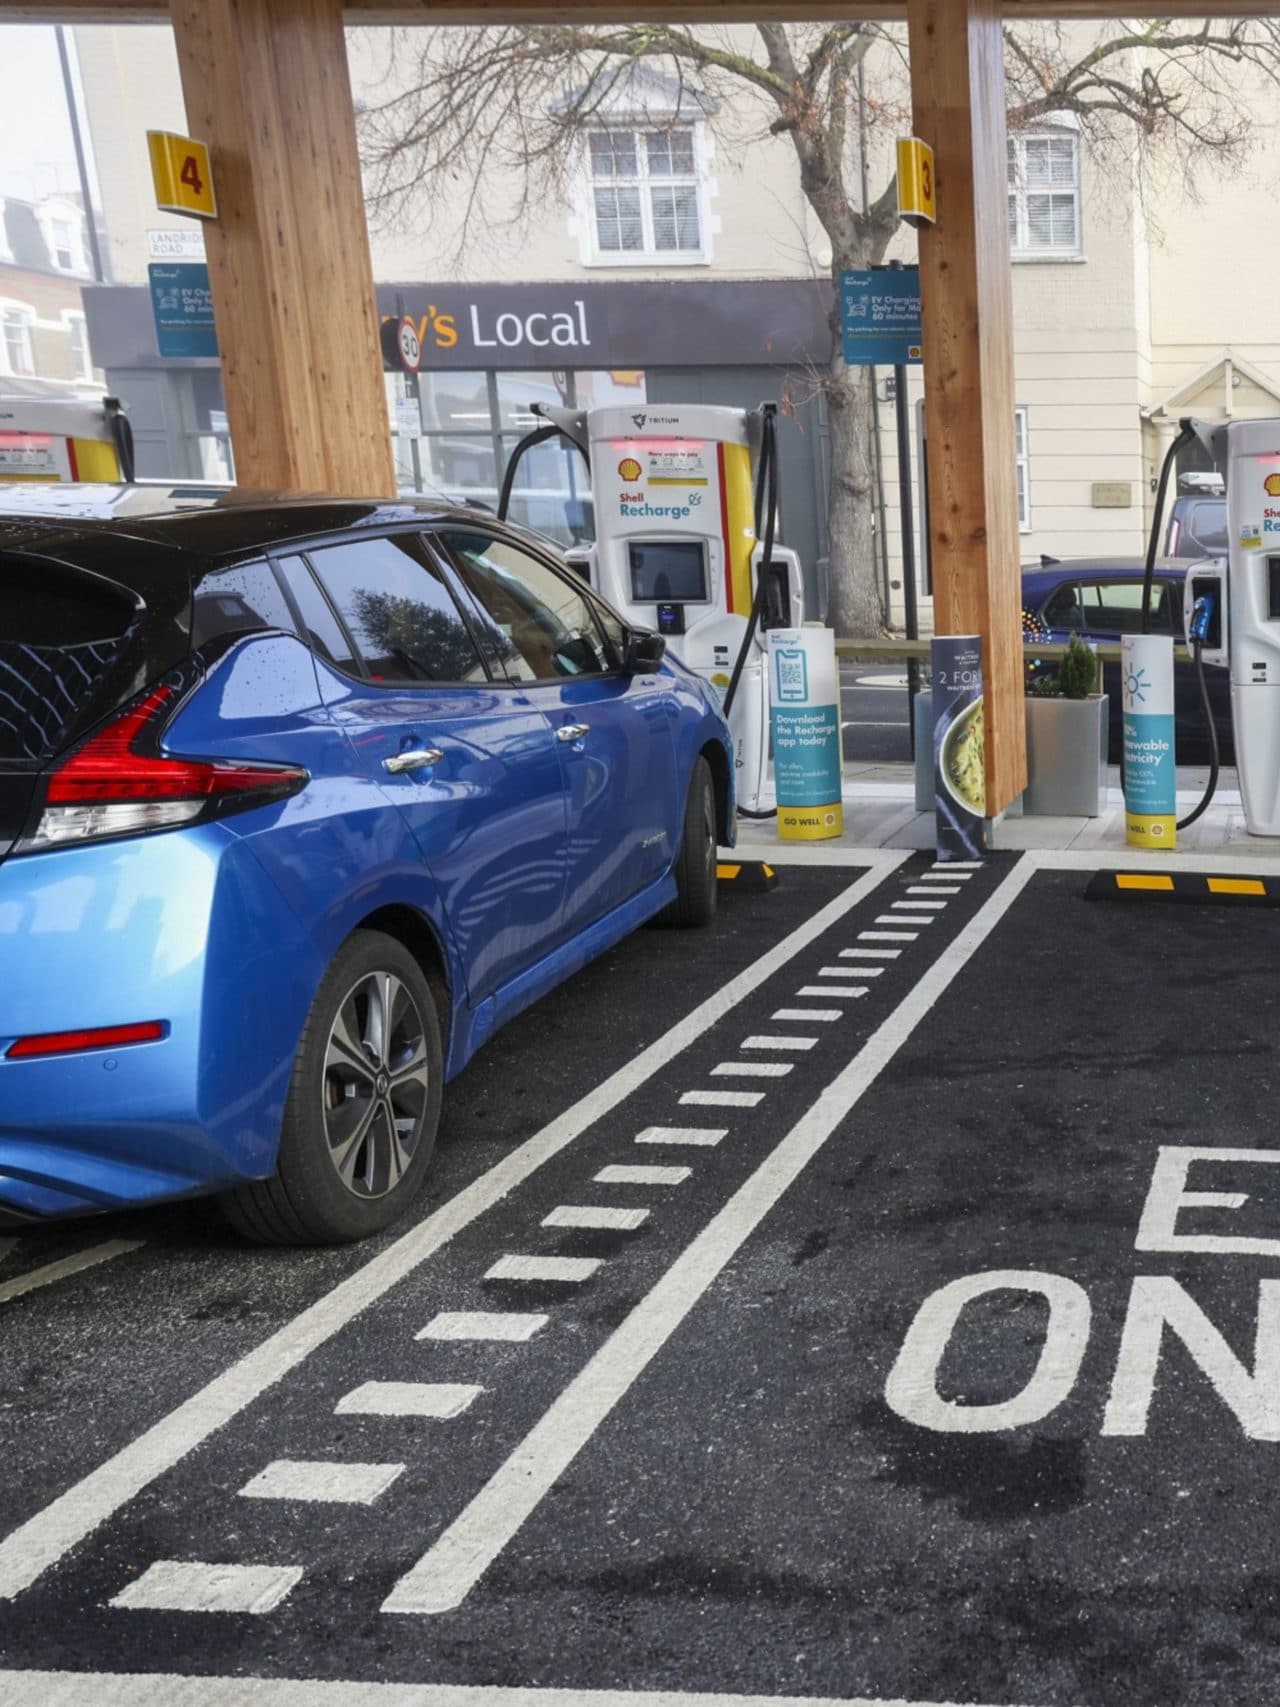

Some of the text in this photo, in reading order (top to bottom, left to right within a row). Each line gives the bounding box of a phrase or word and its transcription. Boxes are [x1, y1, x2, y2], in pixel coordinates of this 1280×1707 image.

[180, 156, 202, 195] 4
[151, 231, 203, 242] LANDRID
[153, 243, 183, 253] ROAD
[871, 296, 882, 304] EV
[872, 304, 891, 313] Only
[872, 312, 884, 320] 60
[470, 301, 591, 347] Local
[402, 333, 418, 358] 30
[620, 492, 644, 503] Shell
[620, 503, 690, 519] Recharge
[939, 671, 948, 684] 2
[776, 713, 825, 724] Download
[777, 724, 836, 736] the Recharge
[778, 736, 827, 748] app today
[799, 818, 821, 826] WELL
